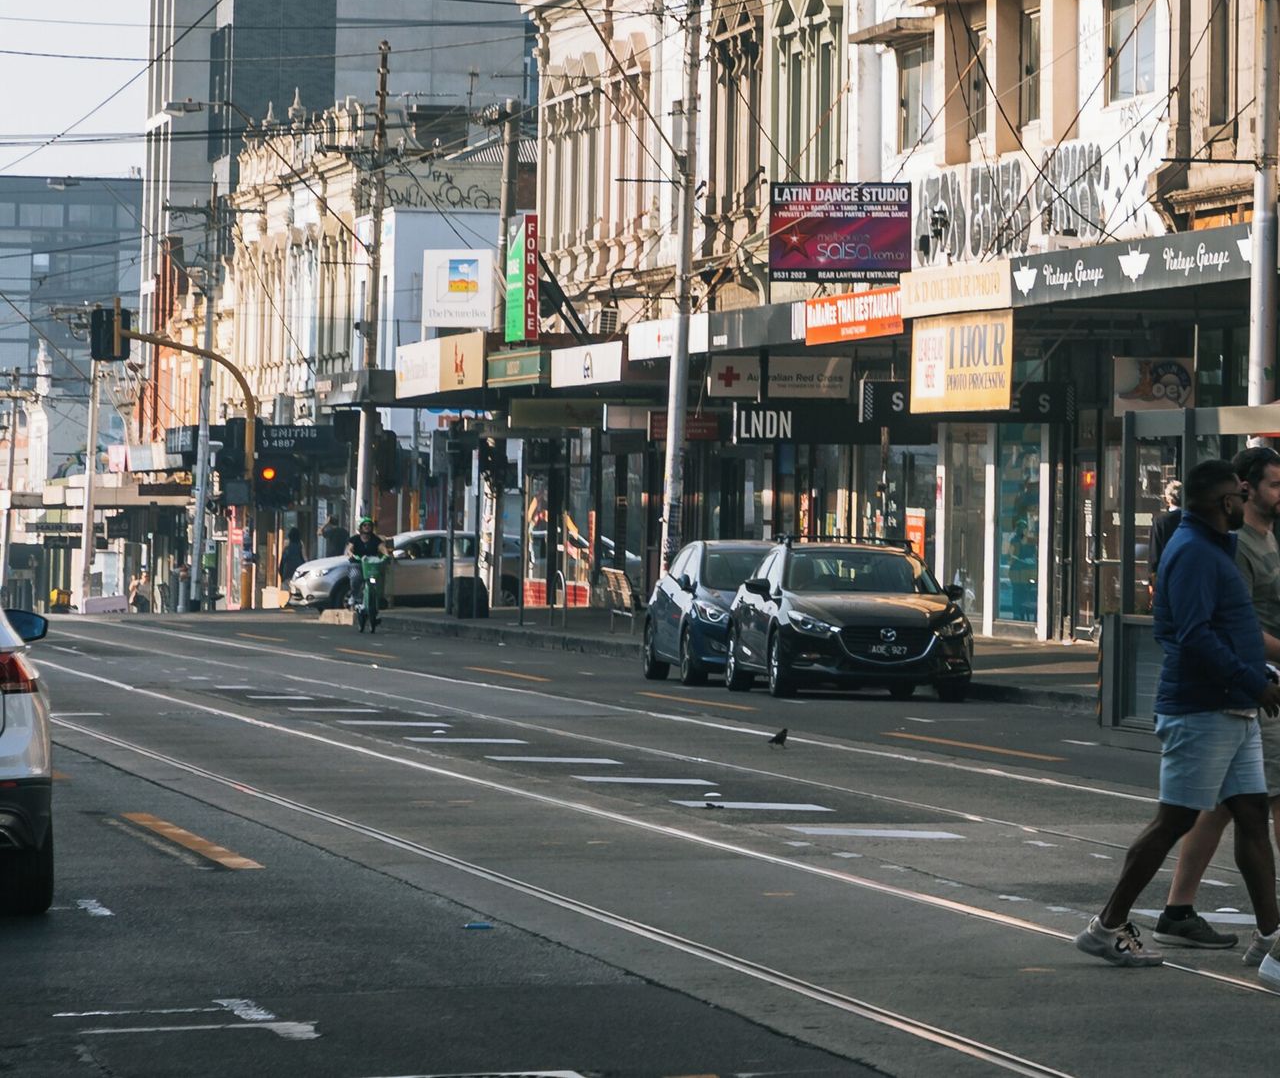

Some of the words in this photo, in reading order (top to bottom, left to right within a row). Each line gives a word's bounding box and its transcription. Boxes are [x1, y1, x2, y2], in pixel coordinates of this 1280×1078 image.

[774, 187, 812, 202] LATIN
[815, 187, 859, 202] DANCE
[862, 187, 909, 202] STUDIO
[527, 223, 536, 265] FOR
[1162, 247, 1196, 276] Vintage
[1196, 242, 1230, 272] Garage
[818, 271, 836, 279] REAR
[866, 271, 899, 279] ENTRANCE
[1043, 264, 1074, 290] Vintage
[1075, 259, 1104, 287] Garage
[525, 273, 536, 331] SALE
[836, 299, 855, 324] THAI
[948, 326, 955, 370] 1
[959, 322, 1005, 368] HOUR
[746, 372, 793, 382] Auralian
[796, 372, 815, 382] Red
[817, 372, 844, 383] Cross
[740, 410, 792, 439] LNDN
